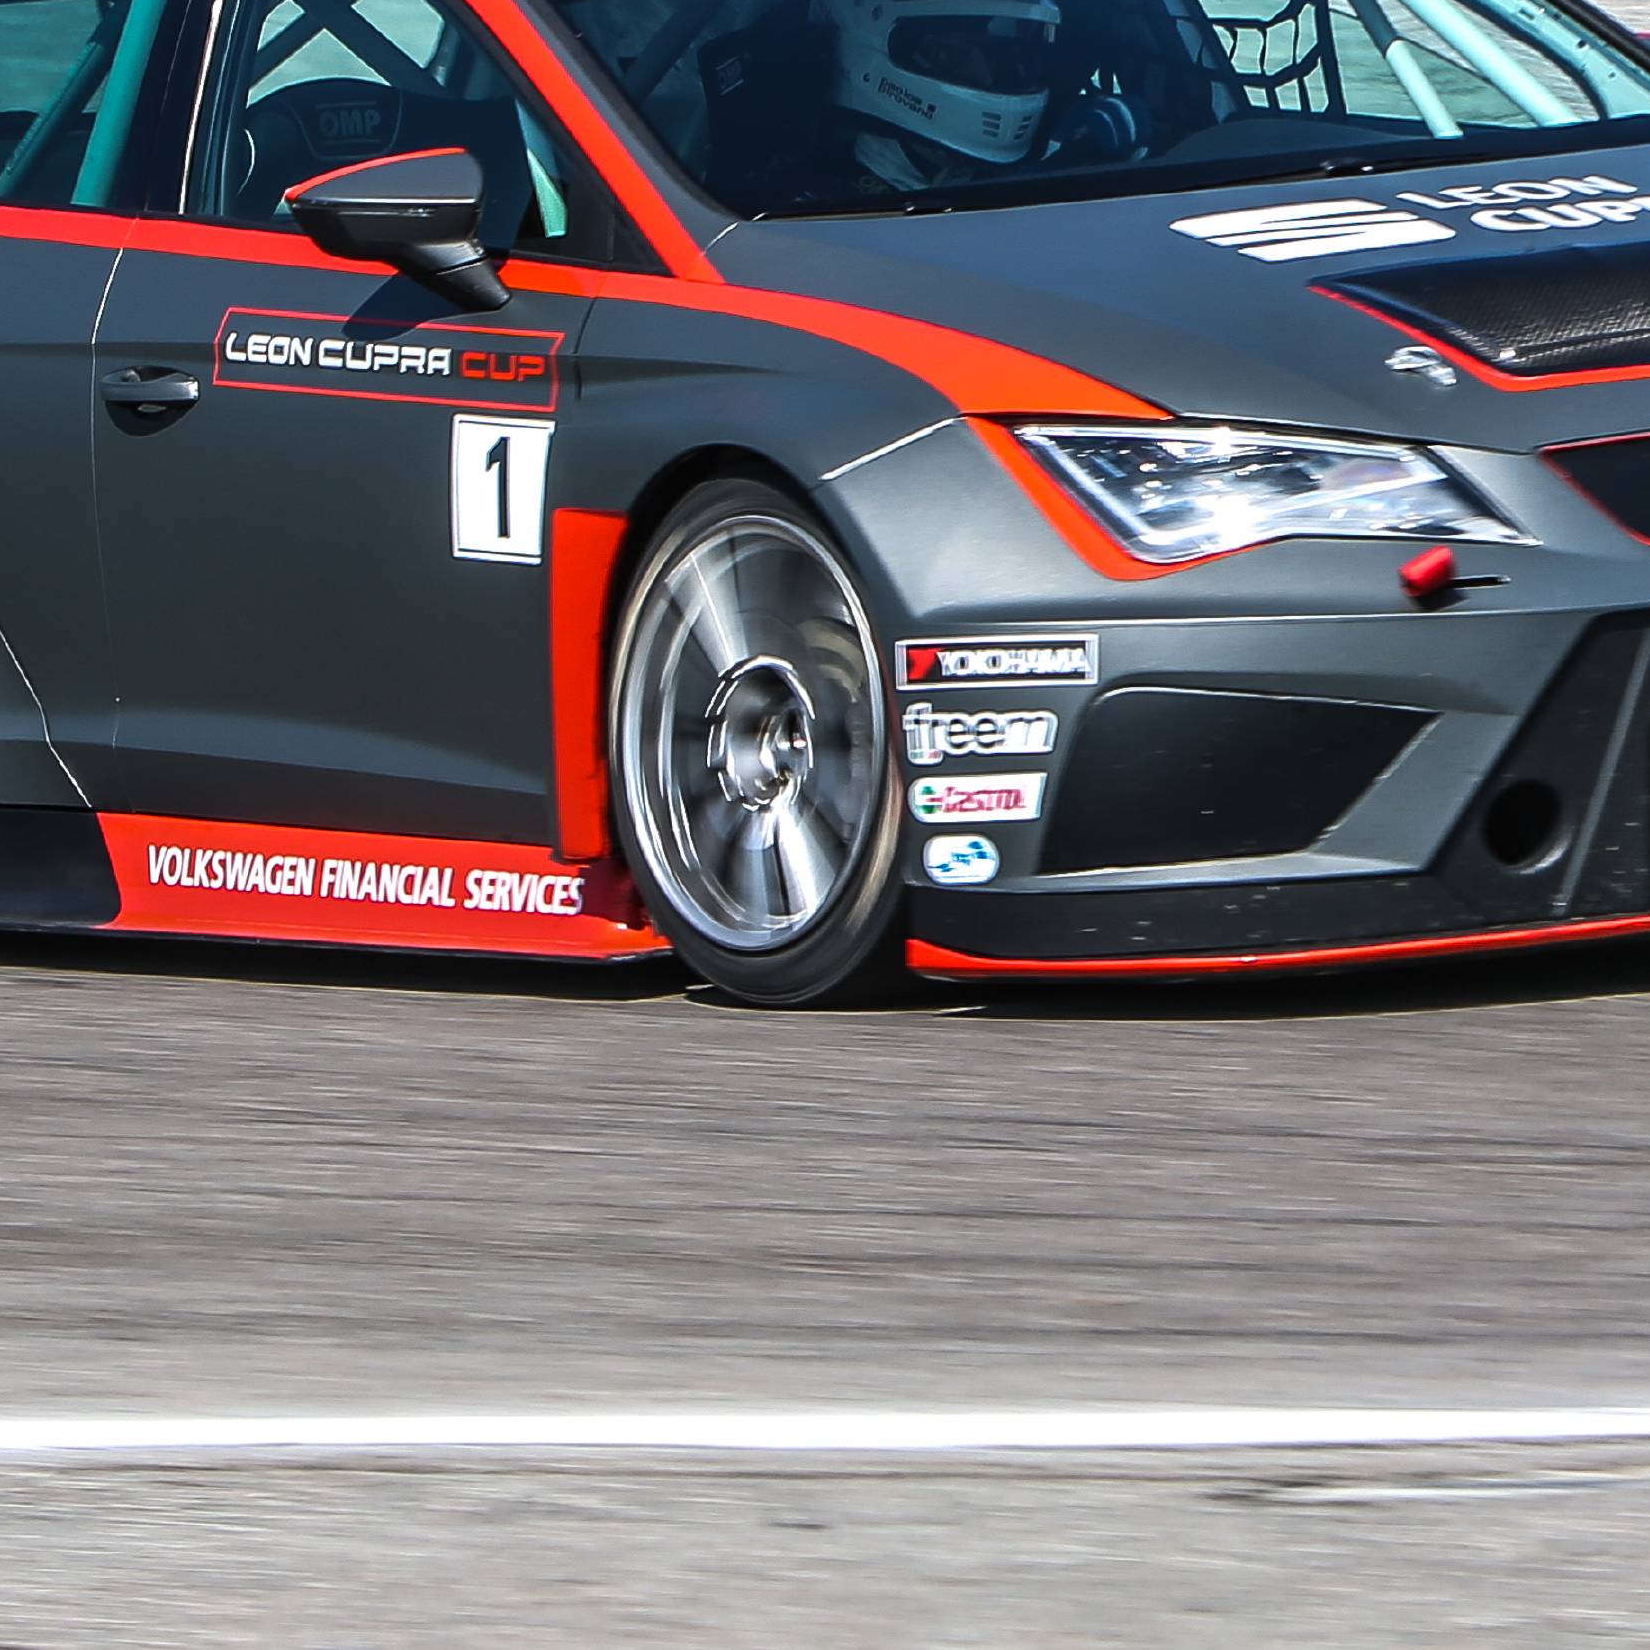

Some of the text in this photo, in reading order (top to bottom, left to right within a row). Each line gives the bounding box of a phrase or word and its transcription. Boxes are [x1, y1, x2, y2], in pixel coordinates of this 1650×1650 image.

[318, 108, 382, 137] OMP
[1395, 175, 1639, 210] LEON
[224, 331, 546, 382] LEON CUPRA CUP
[485, 435, 510, 539] 1
[935, 647, 1091, 676] YOKOHAMA
[148, 844, 585, 917] VOLKSWAGEN FINANCIAL SERVICES
